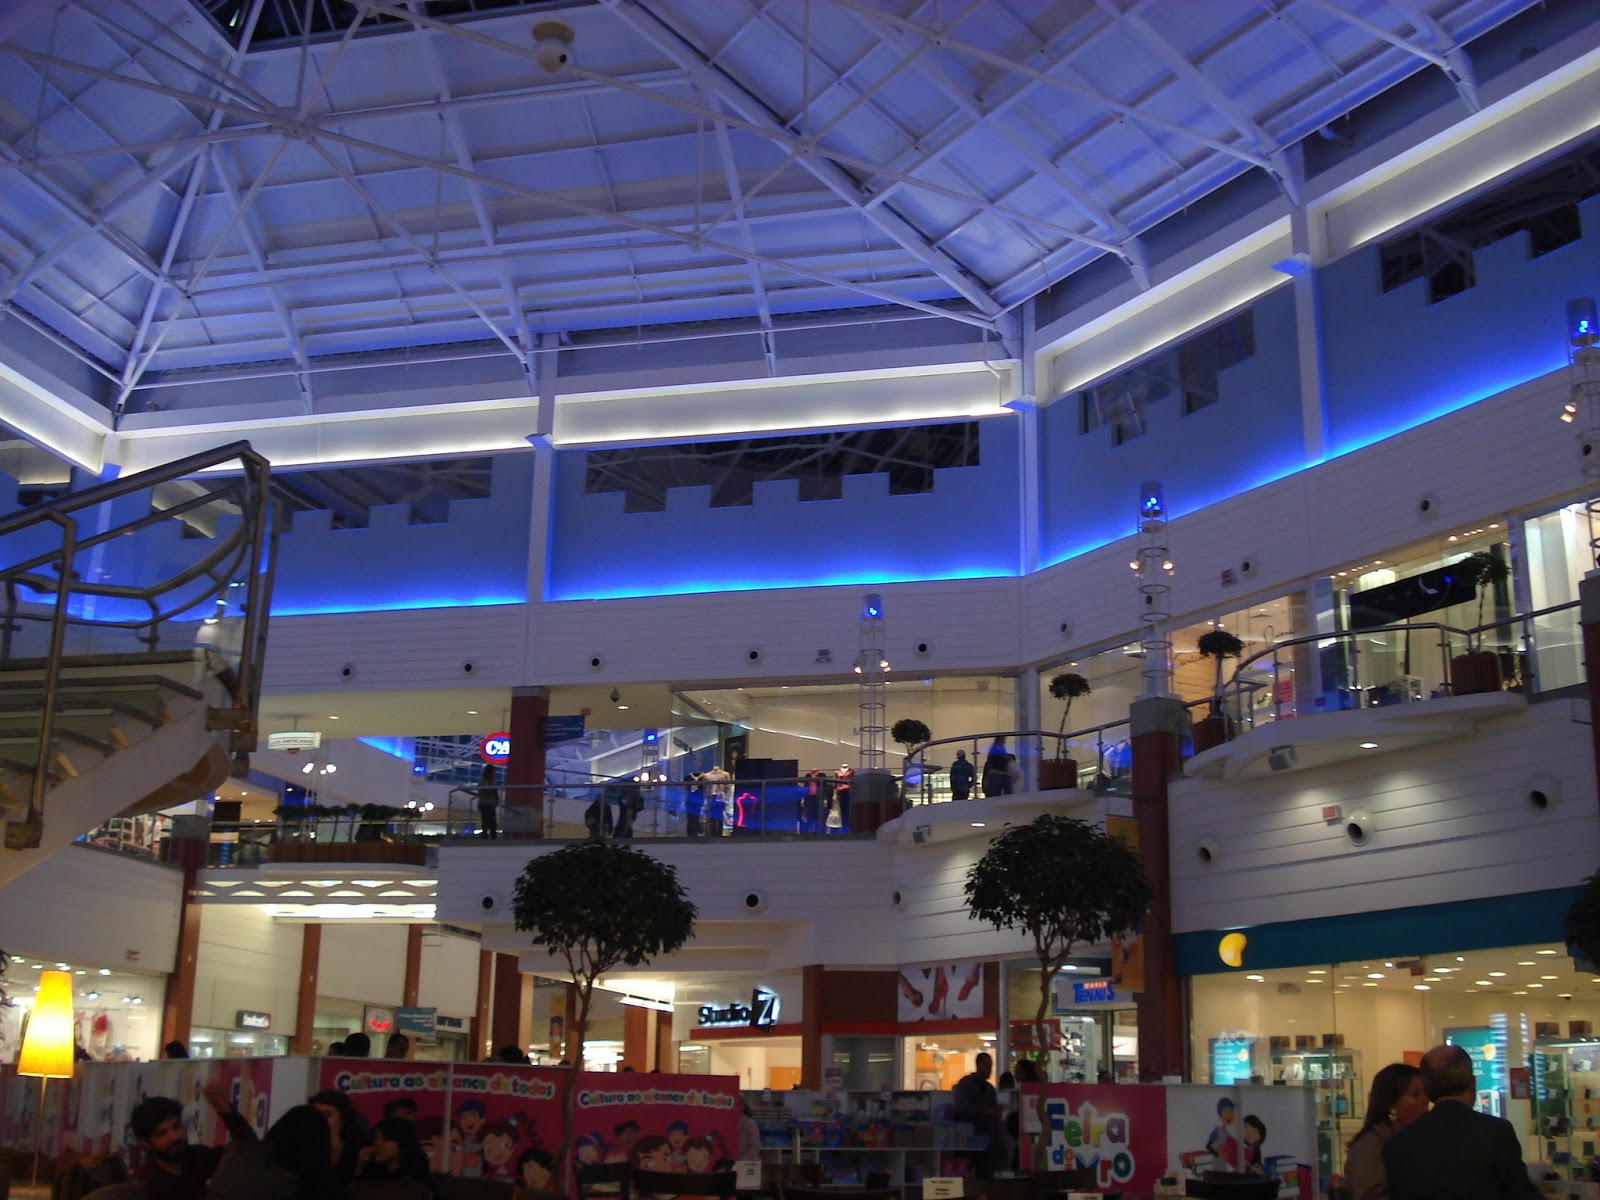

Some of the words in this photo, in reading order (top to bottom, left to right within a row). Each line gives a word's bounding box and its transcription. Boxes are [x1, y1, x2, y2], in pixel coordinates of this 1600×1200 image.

[698, 1003, 752, 1025] Studio
[337, 1073, 400, 1091] Cultura
[403, 1075, 424, 1088] ao
[490, 1074, 509, 1090] de
[511, 1077, 553, 1097] todos
[1046, 1103, 1126, 1148] Feira
[1052, 1144, 1074, 1166] do
